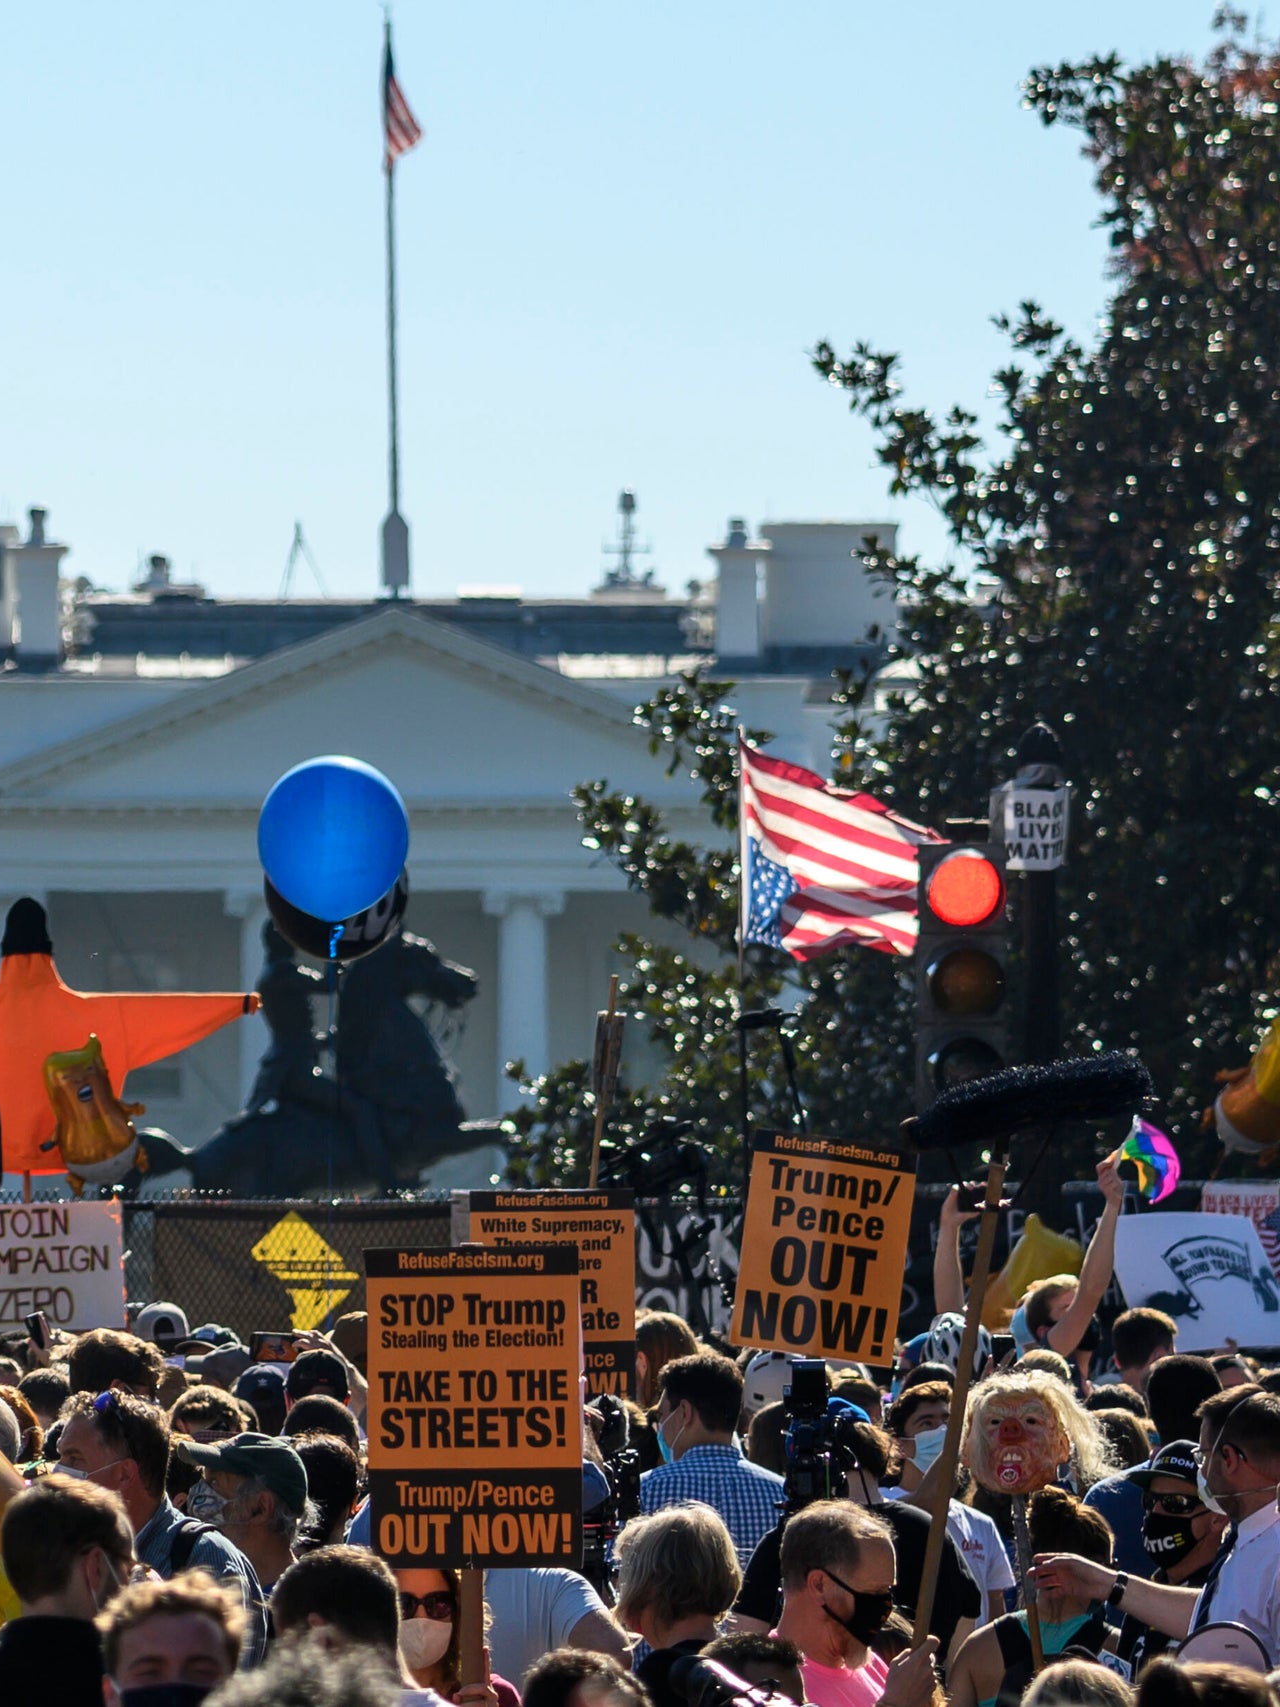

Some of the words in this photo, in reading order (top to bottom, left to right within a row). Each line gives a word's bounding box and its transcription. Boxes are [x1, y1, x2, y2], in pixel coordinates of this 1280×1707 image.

[774, 1135, 900, 1168] RefuseFascism.org
[769, 1158, 901, 1209] Trump/
[495, 1194, 609, 1207] RefuseFascism.org
[481, 1218, 527, 1233] White
[531, 1218, 625, 1236] Supremacy,
[771, 1195, 885, 1241] Pence
[581, 1236, 612, 1251] and
[398, 1251, 545, 1271] RefuseFascism.org
[770, 1236, 878, 1297] OUT
[380, 1293, 455, 1326] STOP
[463, 1293, 566, 1331] Trump
[740, 1289, 888, 1357] NOW!
[381, 1330, 447, 1352] Stealing
[452, 1329, 480, 1348] the
[485, 1329, 564, 1348] Election!
[378, 1370, 450, 1402] TAKE
[459, 1370, 497, 1402] TO
[506, 1369, 568, 1402] THE
[380, 1406, 566, 1449] STREETS!
[395, 1480, 555, 1513] Trump/Pence
[379, 1513, 451, 1555] OUT
[462, 1513, 571, 1555] NOW!
